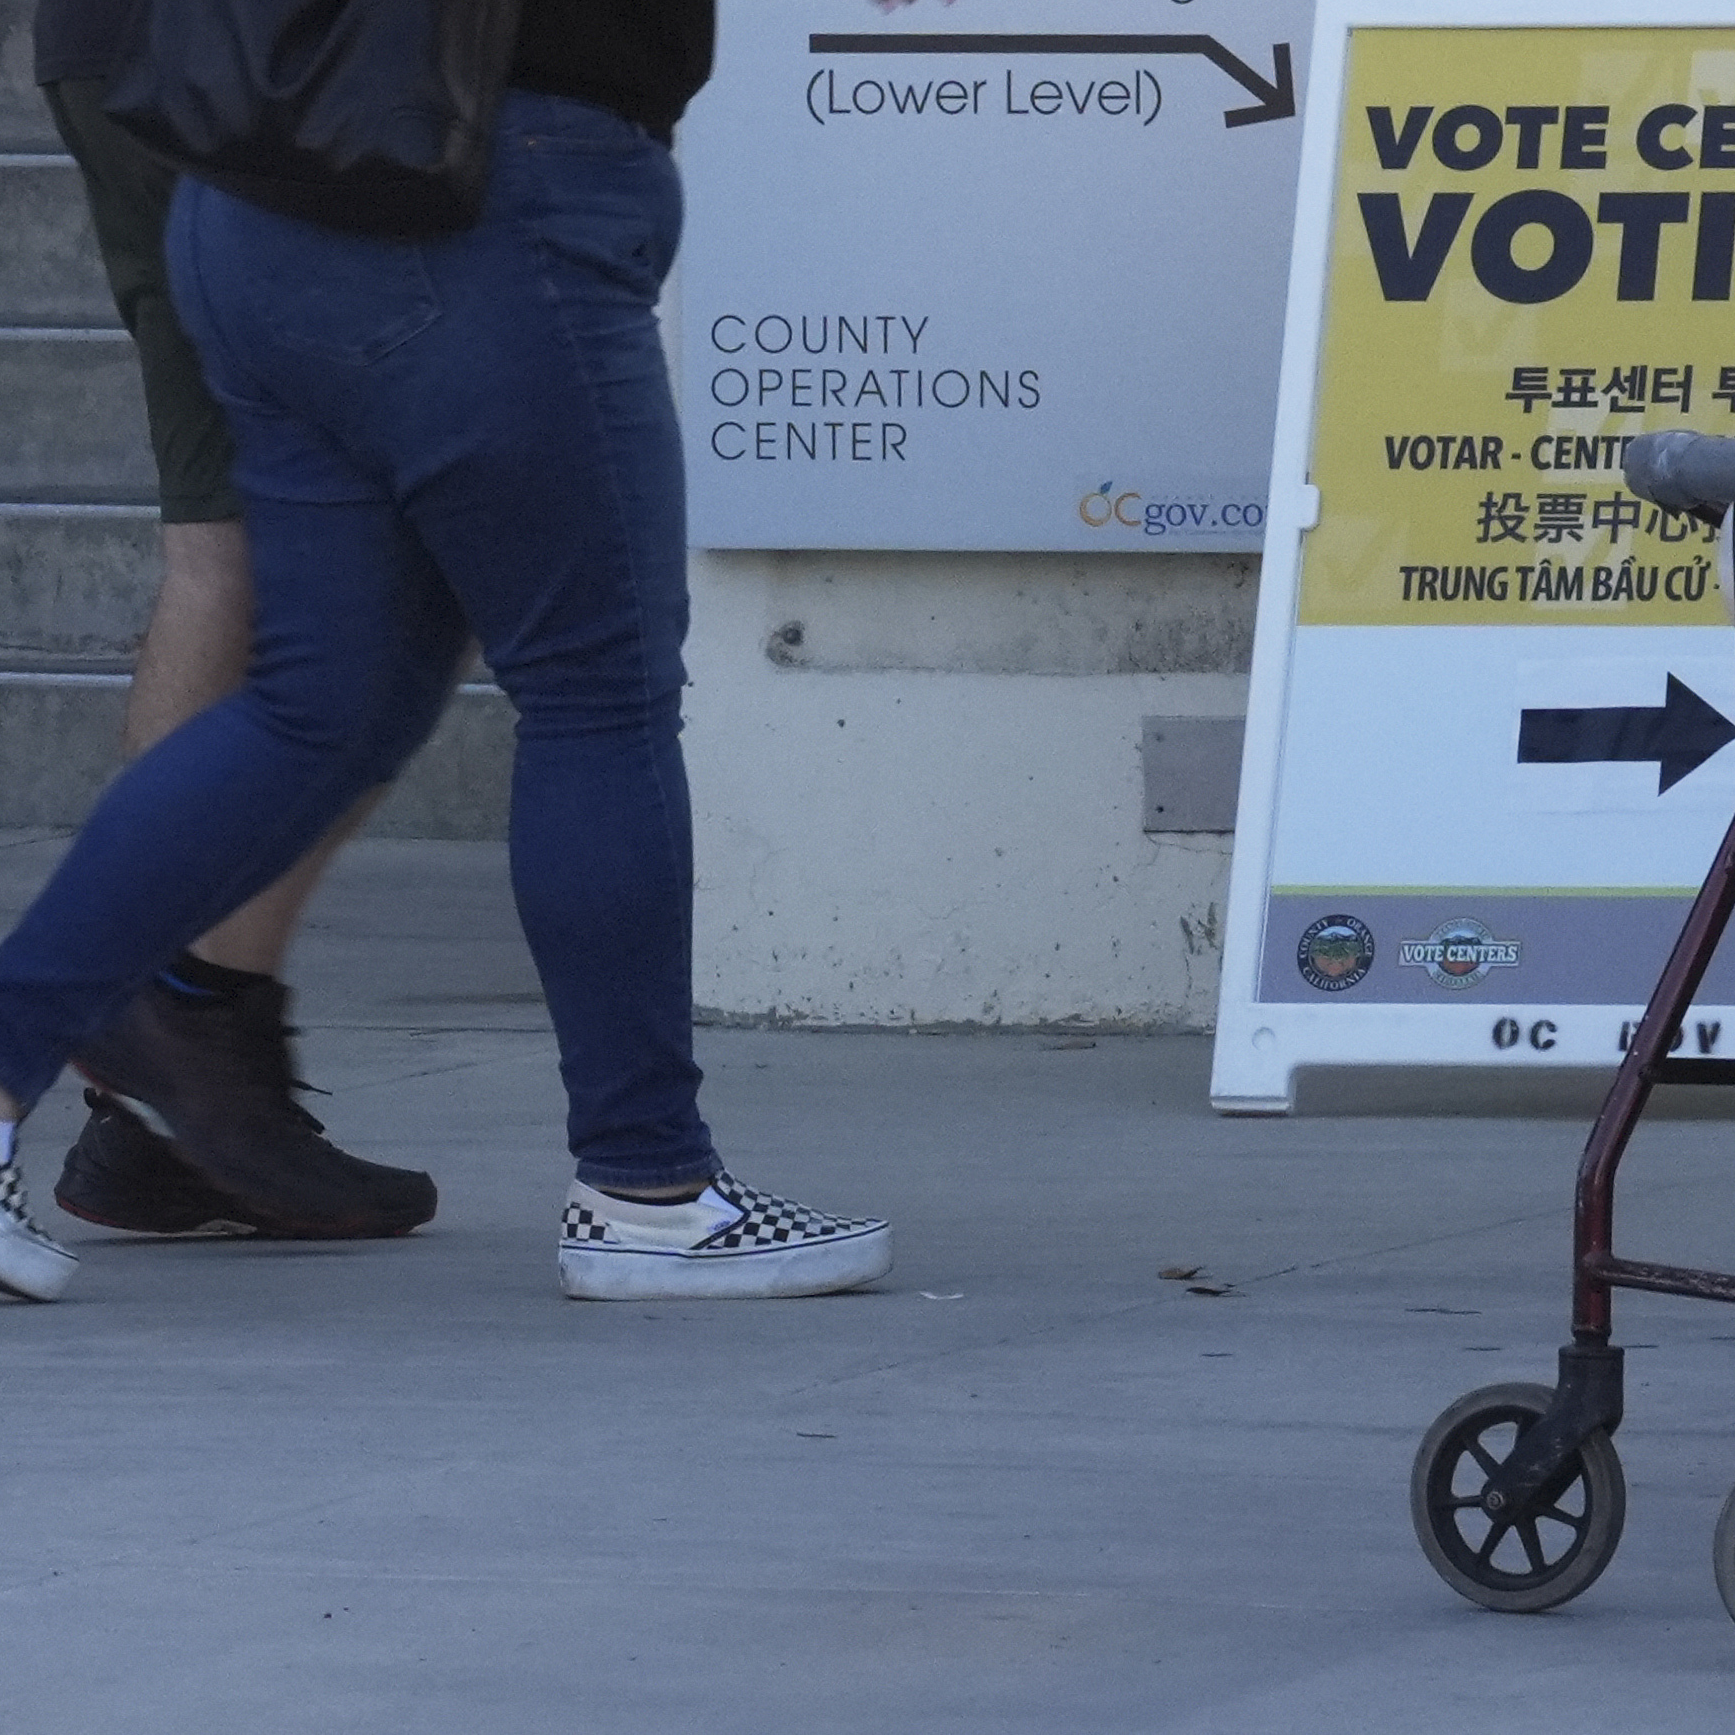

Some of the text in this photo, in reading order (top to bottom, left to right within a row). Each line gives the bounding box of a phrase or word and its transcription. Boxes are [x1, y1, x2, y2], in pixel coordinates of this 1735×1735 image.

[806, 69, 1162, 127] (Lower Level)
[1365, 104, 1610, 172] VOTE
[710, 314, 929, 355] COUNTY
[710, 367, 1041, 409] OPERATIONS
[1504, 364, 1694, 414] 투표센터
[711, 421, 907, 461] CENTER
[1384, 435, 1504, 471] VOTAR
[1531, 436, 1637, 470] CENT
[1399, 565, 1509, 602] TRUNG
[1515, 558, 1584, 602] TÂM
[1591, 555, 1660, 602] BẦU
[1664, 554, 1712, 602] CỬ
[1404, 945, 1518, 962] VOTE CENTERS
[1303, 967, 1366, 990] CALIFORNIA
[1491, 1017, 1557, 1051] OC
